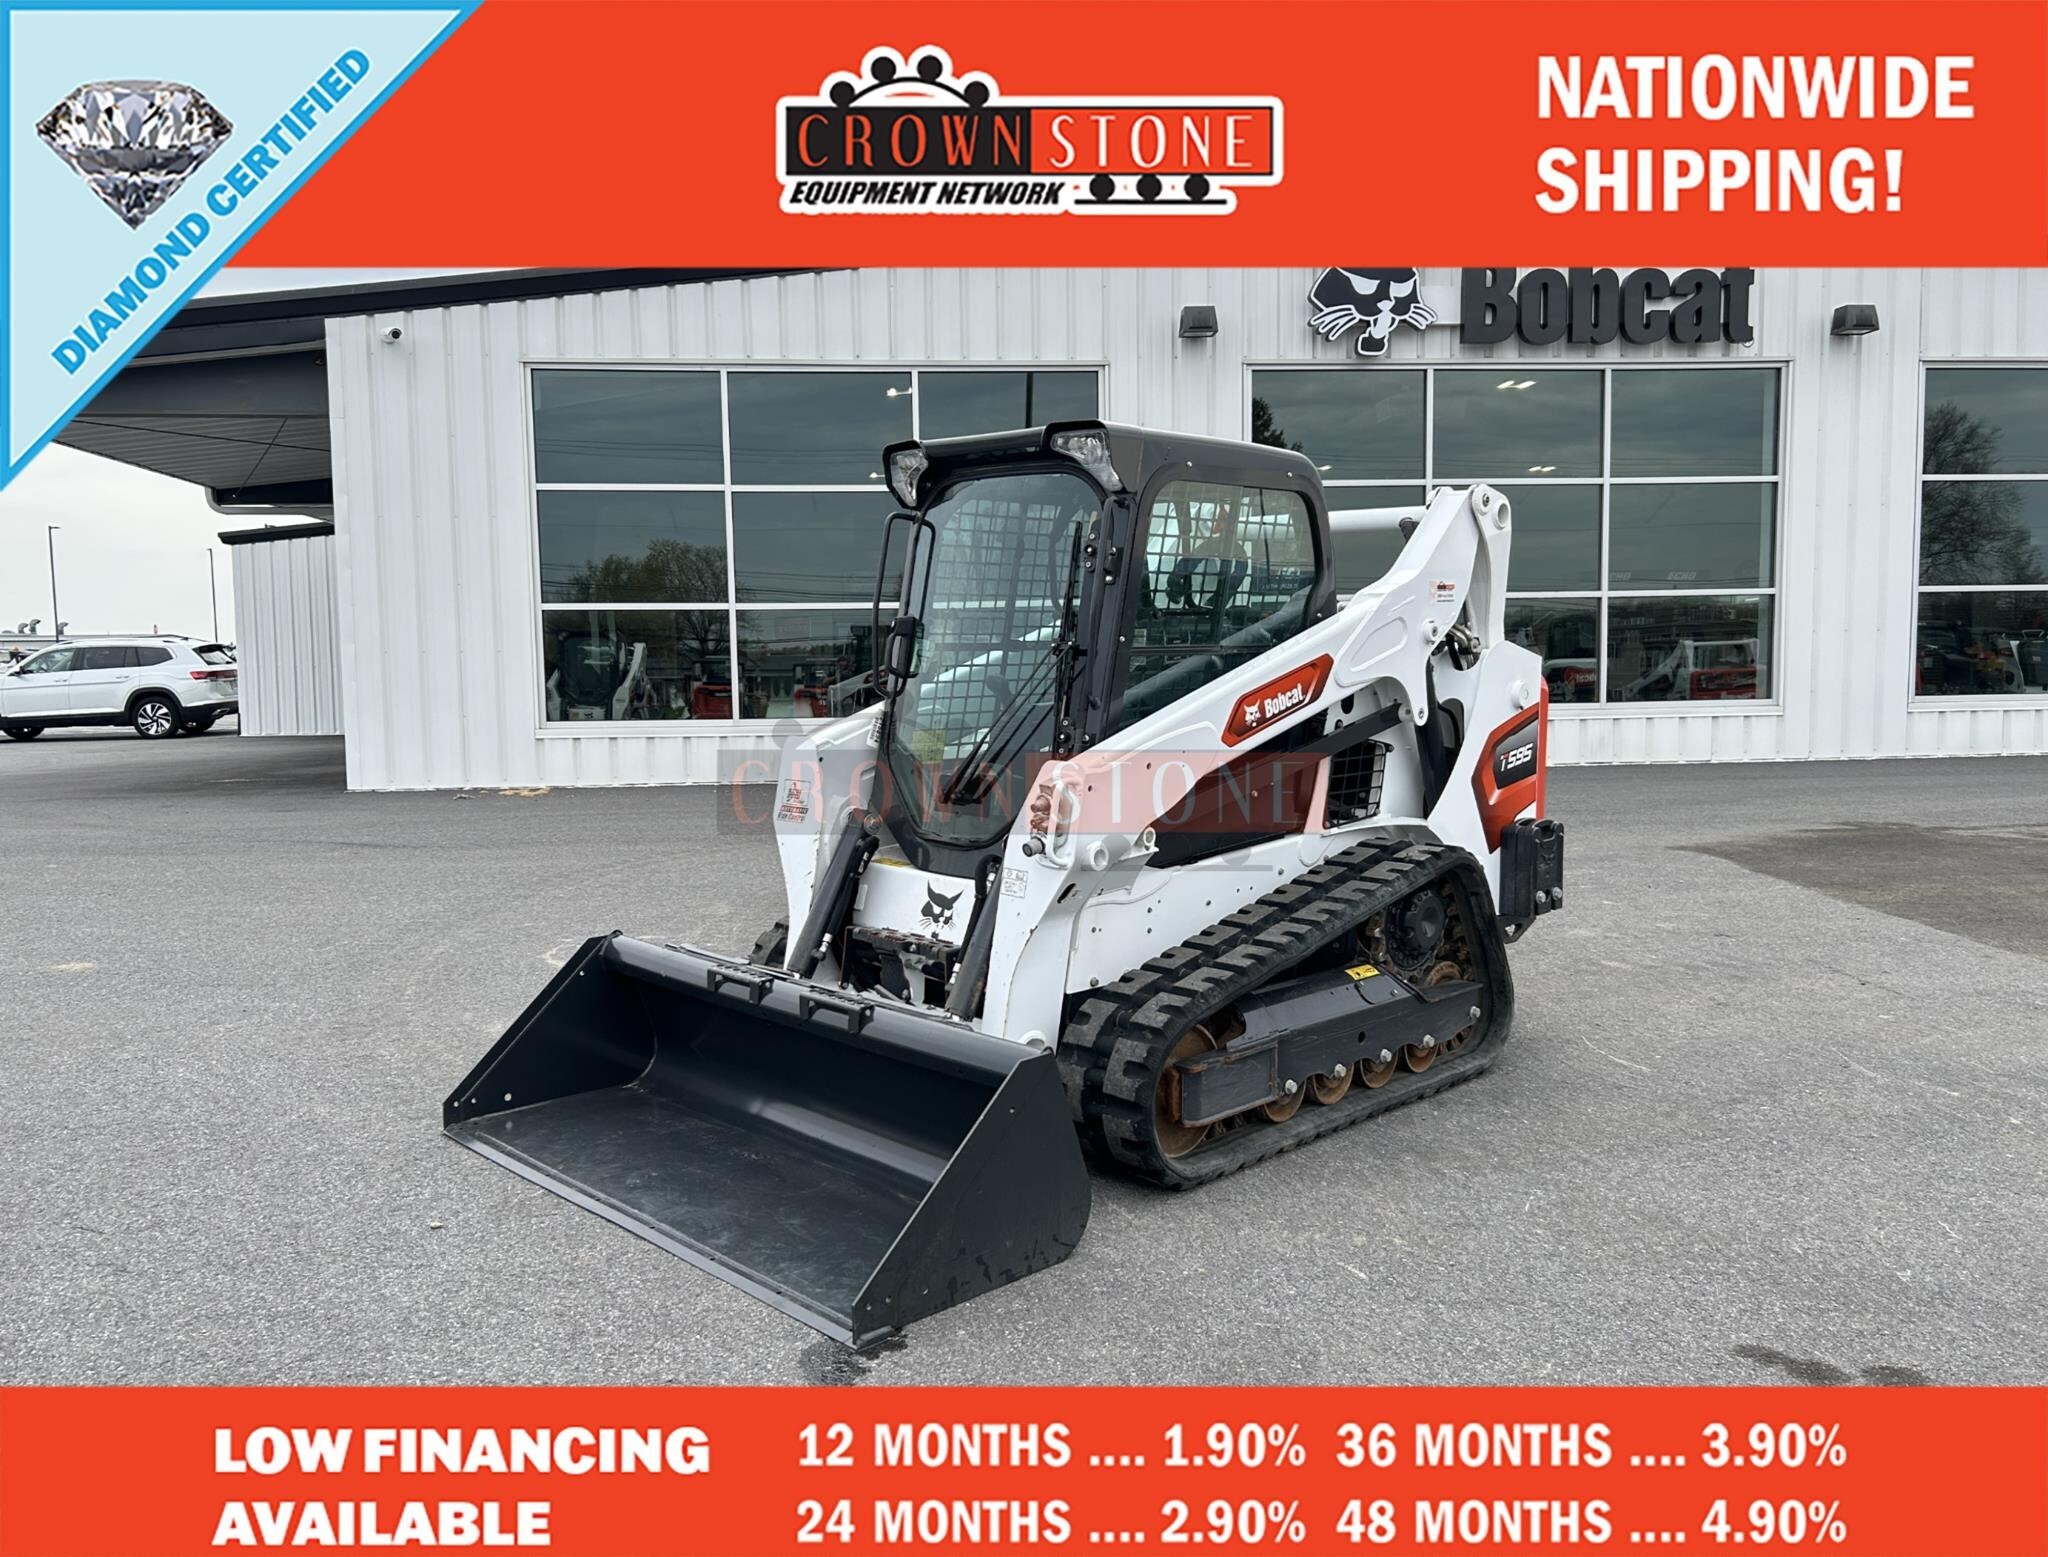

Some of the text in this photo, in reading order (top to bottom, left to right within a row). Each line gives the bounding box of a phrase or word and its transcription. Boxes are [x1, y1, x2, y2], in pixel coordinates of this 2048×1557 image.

[1459, 267, 1755, 345] Bobcat
[1263, 682, 1304, 719] Bobcat
[1499, 742, 1535, 773] T595
